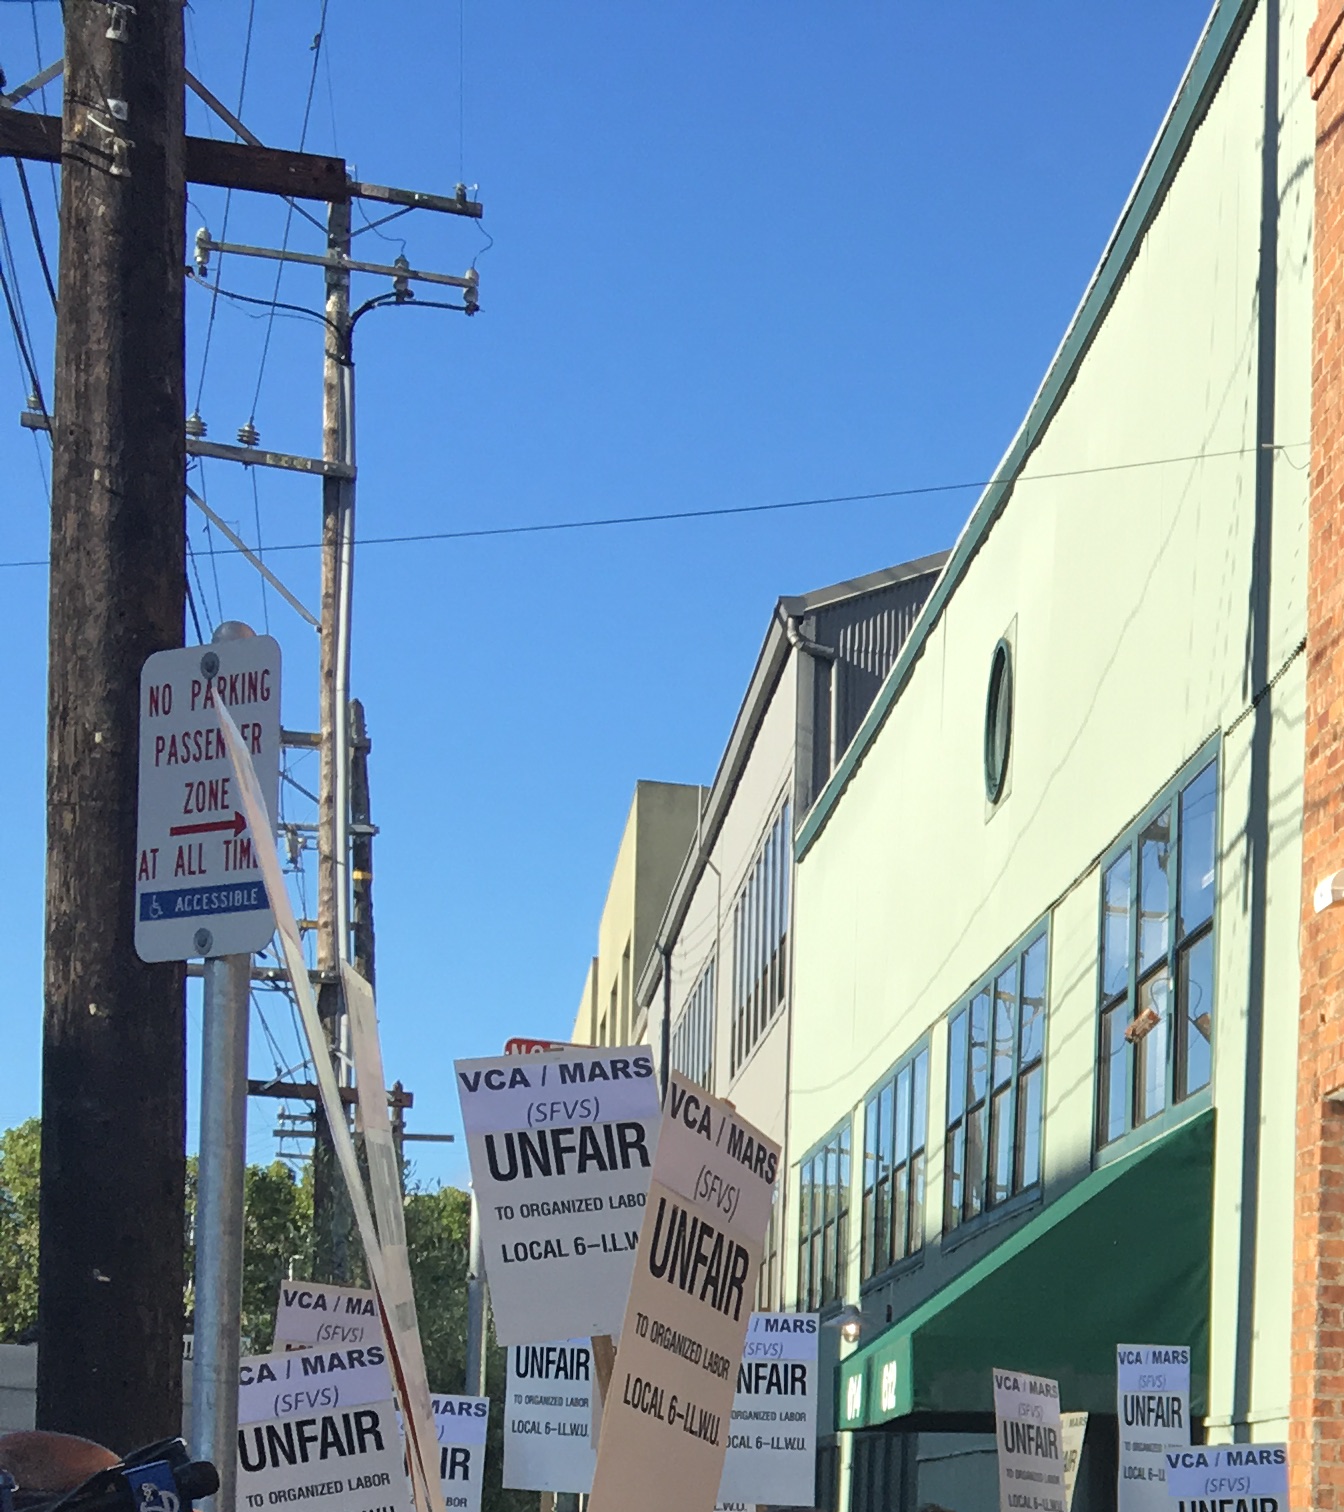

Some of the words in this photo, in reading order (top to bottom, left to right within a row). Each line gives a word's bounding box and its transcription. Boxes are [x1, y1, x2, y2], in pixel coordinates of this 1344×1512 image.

[149, 684, 172, 717] NO
[190, 669, 271, 712] PARKING
[155, 723, 262, 767] PASSENER
[183, 778, 230, 814] ZONE
[138, 849, 158, 881] AT
[174, 845, 207, 877] ALL
[223, 839, 258, 871] TIM
[174, 888, 258, 912] ACCESSIBLE
[459, 1068, 531, 1092] VCA
[541, 1065, 547, 1086] /
[559, 1057, 653, 1084] MARS
[527, 1097, 600, 1127] (SFVS)
[671, 1082, 711, 1141] VCA
[727, 1123, 778, 1185] MARS
[485, 1122, 651, 1181] UNFAIR
[495, 1206, 514, 1220] TO
[520, 1197, 603, 1218] ORGANIZED
[609, 1193, 647, 1209] LABO
[694, 1165, 740, 1223] (SFVS)
[502, 1239, 569, 1263] LOCAL
[574, 1231, 640, 1255] 6-I.L.W
[650, 1197, 749, 1322] UNFAIR
[283, 1290, 327, 1311] VCA
[345, 1297, 377, 1316] MA
[317, 1323, 364, 1343] (SFVS)
[765, 1318, 816, 1334] MARS
[635, 1312, 649, 1338] TO
[650, 1320, 702, 1364] ORGANIZED
[702, 1348, 730, 1380] LABOR
[743, 1342, 784, 1359] (SFVS)
[1118, 1351, 1142, 1365] VCA
[1152, 1350, 1189, 1365] MARS
[239, 1363, 277, 1386] CA
[301, 1346, 385, 1376] MARS
[515, 1345, 590, 1381] UNFAIR
[737, 1362, 807, 1396] NFAIR
[995, 1375, 1020, 1392] VCA
[1029, 1381, 1059, 1398] MARS
[274, 1386, 339, 1416] (SFVS)
[514, 1394, 523, 1405] TO
[525, 1395, 563, 1407] ORGANIZED
[565, 1397, 589, 1408] LABOR
[623, 1373, 664, 1420] LOCAL
[1123, 1394, 1183, 1429] UNFAIR
[511, 1420, 542, 1435] LOCAL
[731, 1409, 777, 1422] ORGANIZED
[780, 1411, 806, 1422] LABOR
[238, 1410, 385, 1472] UNFAIR
[726, 1435, 752, 1449] OCAL
[1003, 1421, 1059, 1460] UNFAIR
[1064, 1450, 1078, 1472] AIR
[1123, 1466, 1146, 1480] LOCAL
[1166, 1453, 1208, 1469] VCA
[1226, 1449, 1286, 1467] MARS
[246, 1494, 264, 1508] TO
[269, 1480, 343, 1504] ORGANIZED
[348, 1473, 390, 1491] LABOR
[1205, 1476, 1250, 1496] (SFVS)
[446, 1497, 467, 1507] BOR
[1008, 1494, 1032, 1509] LOCAL
